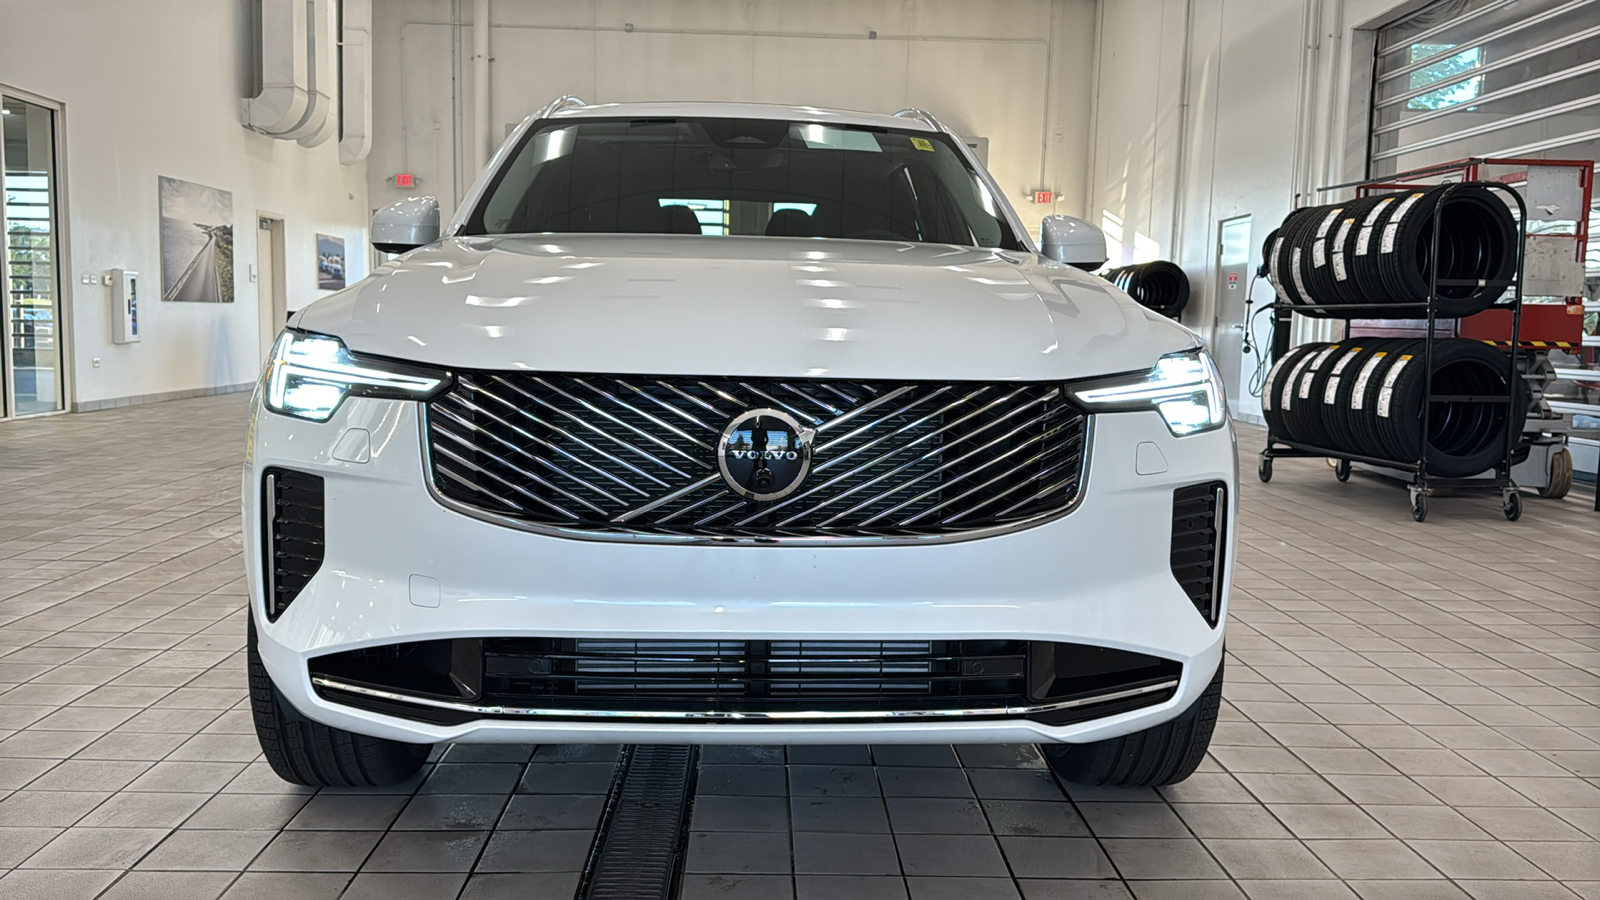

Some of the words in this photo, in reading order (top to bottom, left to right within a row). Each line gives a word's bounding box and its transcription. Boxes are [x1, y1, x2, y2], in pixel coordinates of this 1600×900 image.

[397, 174, 412, 185] EXIT
[1037, 192, 1052, 203] EXIT
[731, 450, 798, 460] VOLVO
